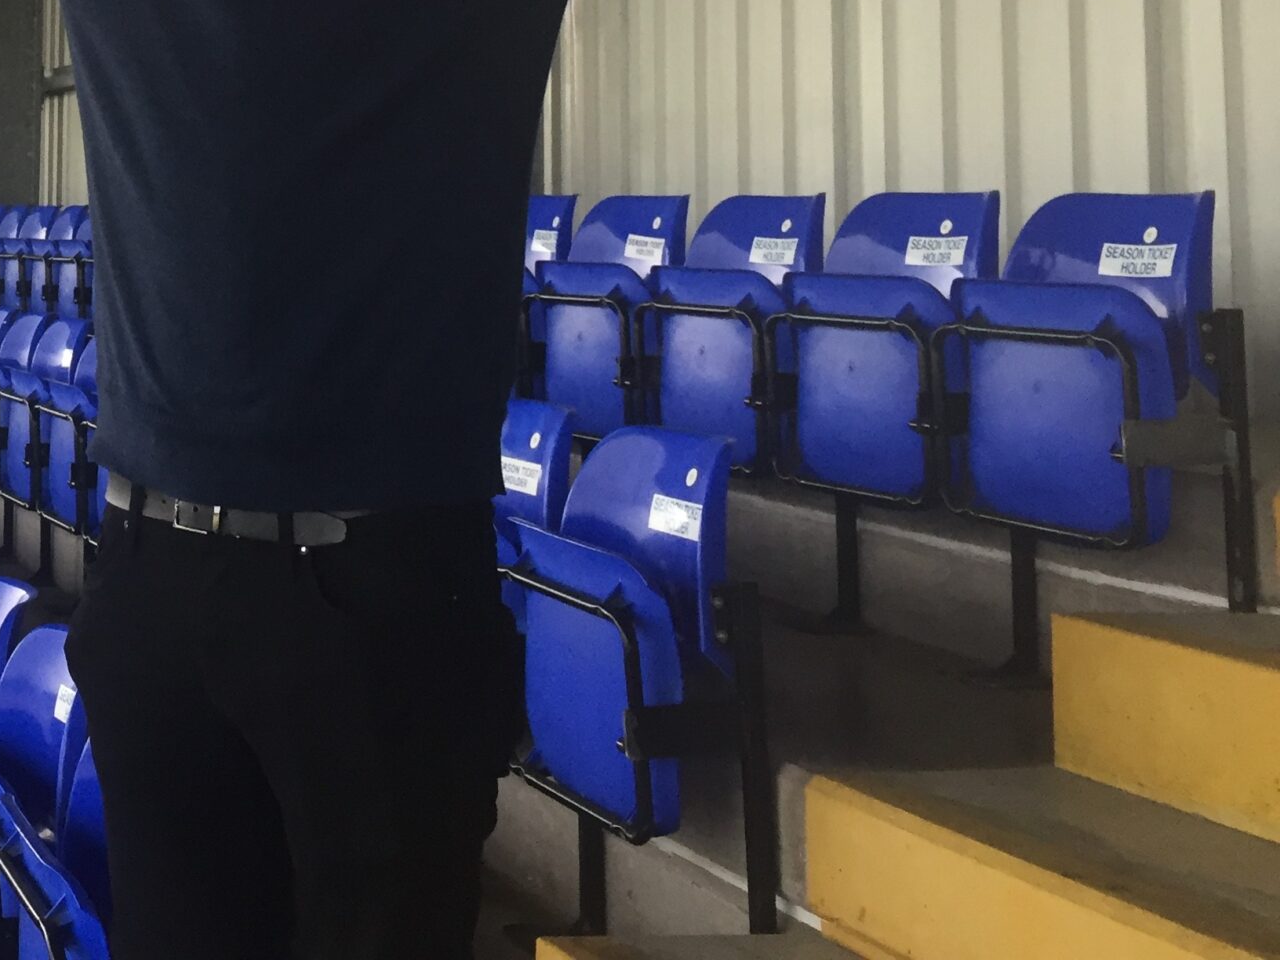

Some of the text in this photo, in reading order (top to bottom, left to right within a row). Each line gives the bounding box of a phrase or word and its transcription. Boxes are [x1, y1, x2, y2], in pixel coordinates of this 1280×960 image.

[910, 238, 943, 250] SEASON
[921, 251, 952, 264] HOLDER
[1105, 245, 1175, 260] SEASON TICKET
[1120, 262, 1157, 275] HOLDER
